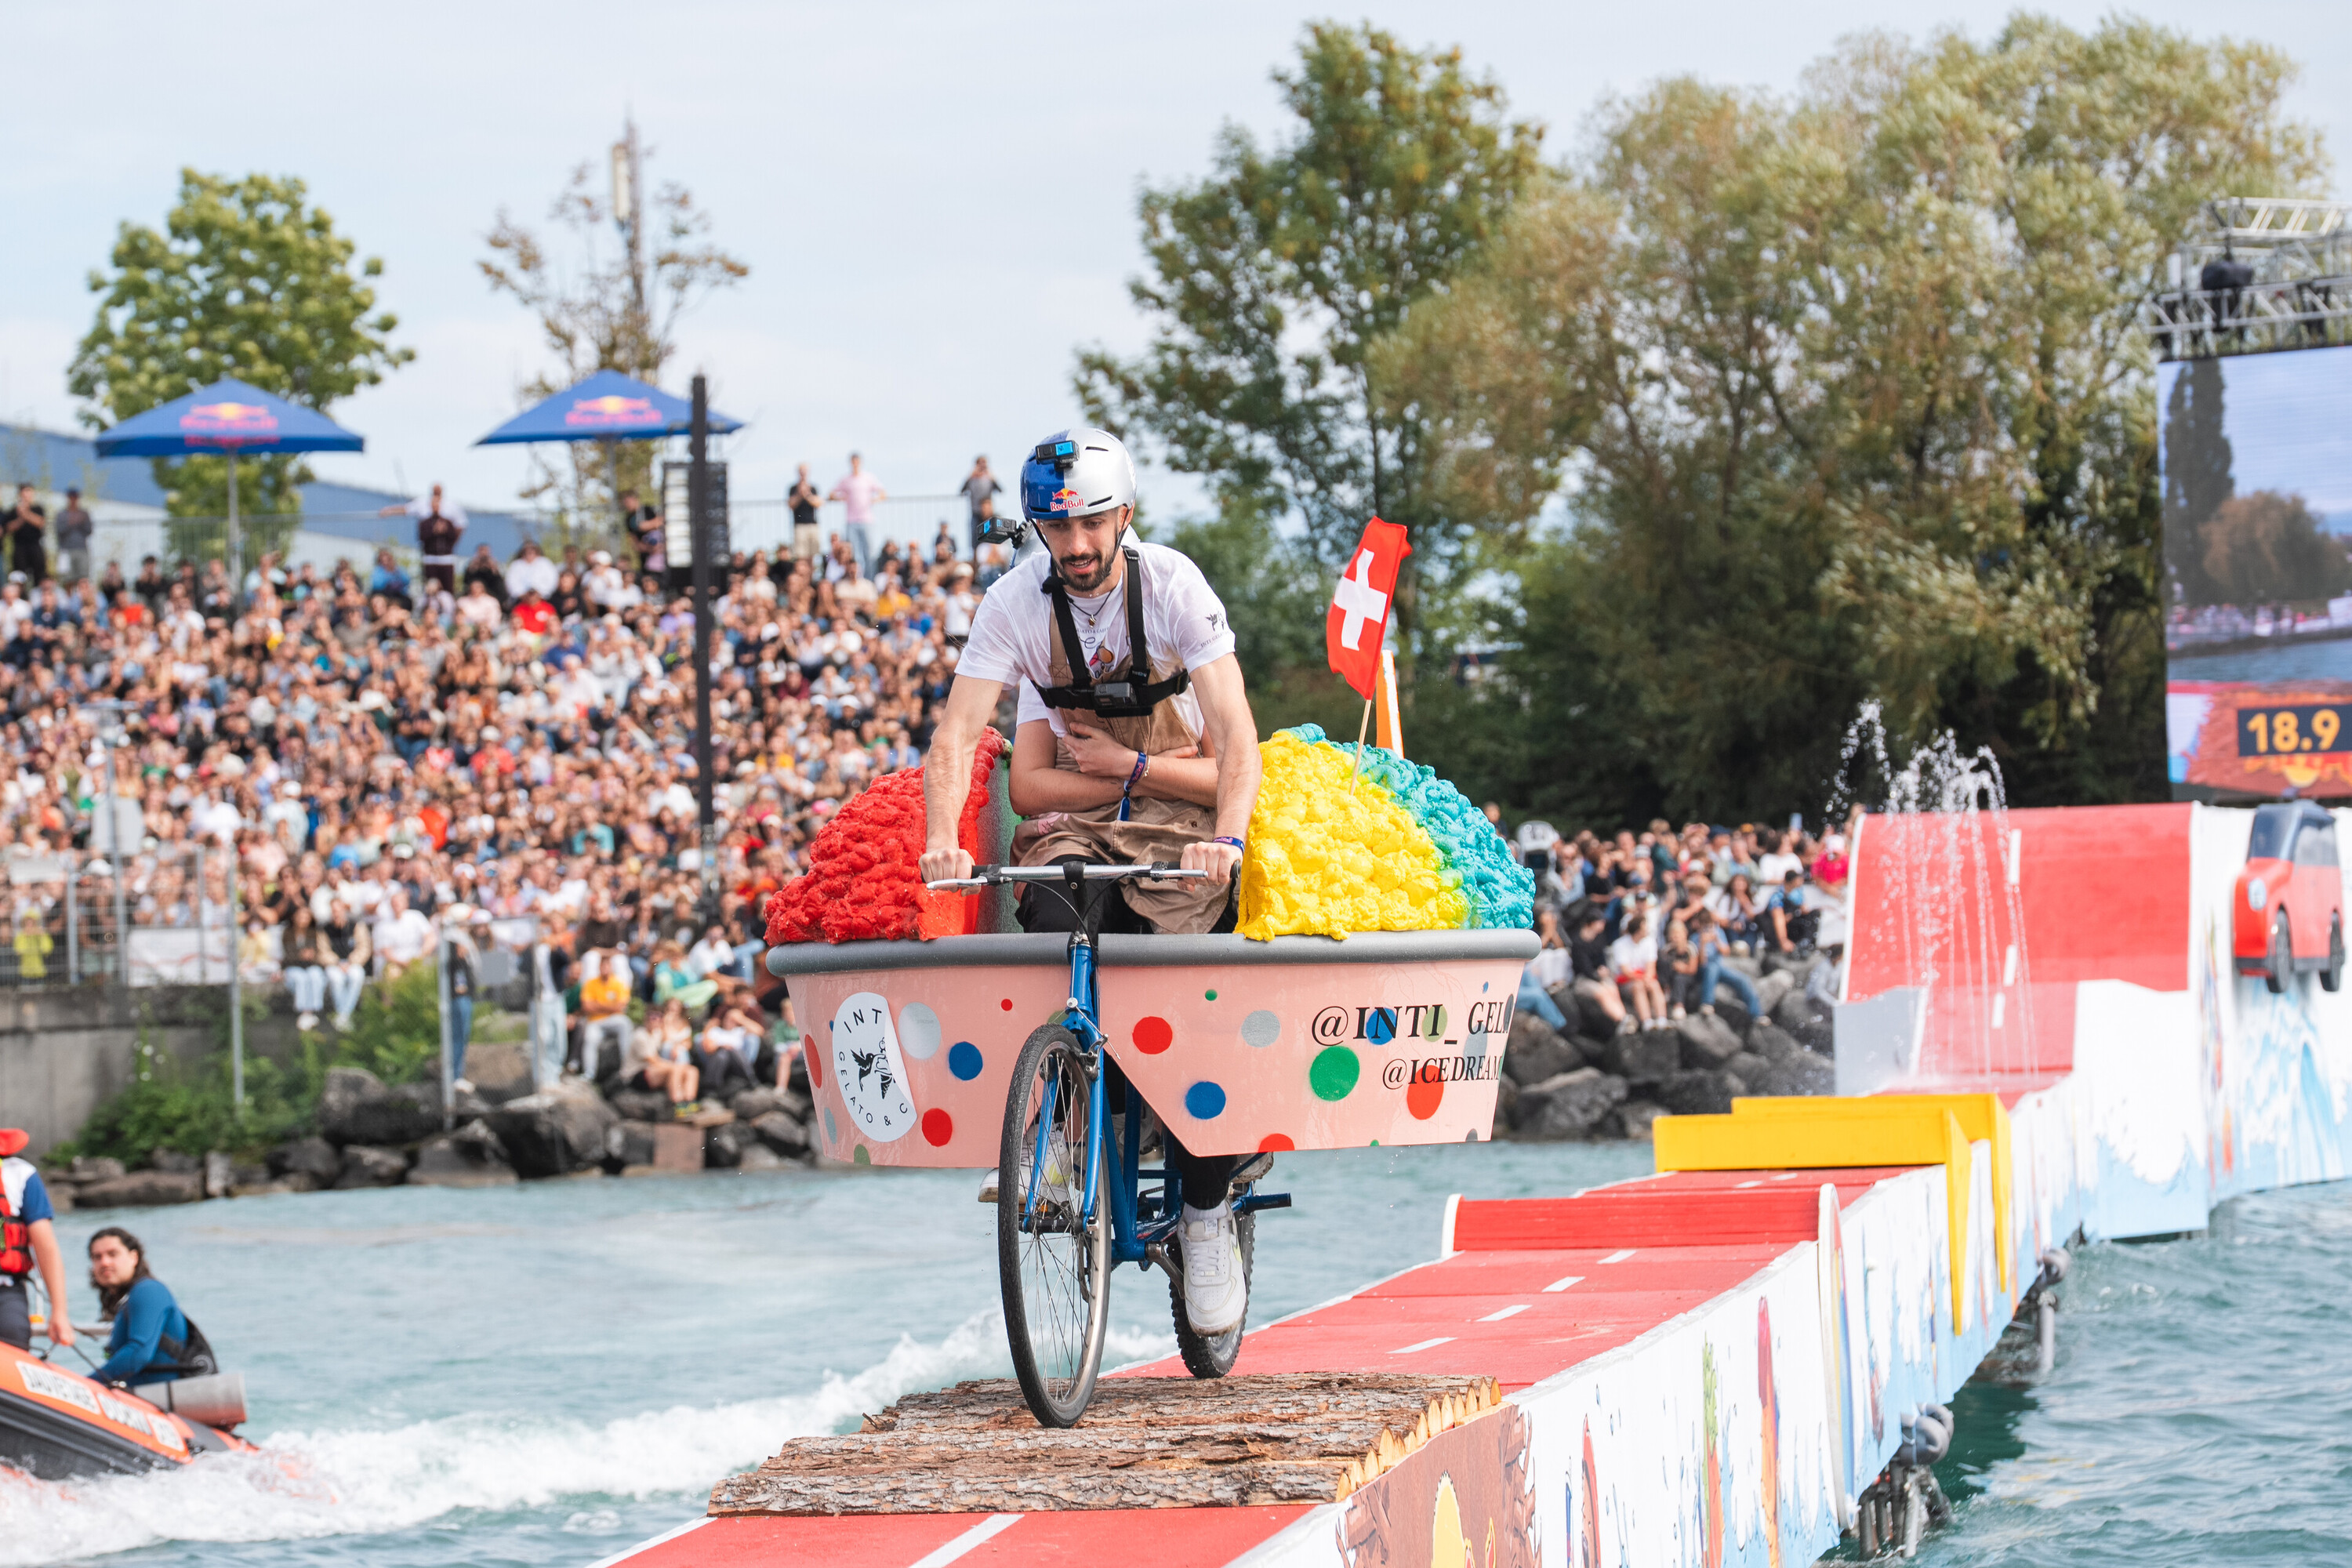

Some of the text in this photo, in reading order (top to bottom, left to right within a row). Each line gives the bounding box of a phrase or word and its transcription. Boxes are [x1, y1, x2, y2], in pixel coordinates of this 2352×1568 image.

[1051, 498, 1084, 511] Red Bull
[2245, 709, 2341, 753] 18.9
[838, 1051, 874, 1123] GELATO
[884, 1115, 892, 1127] &
